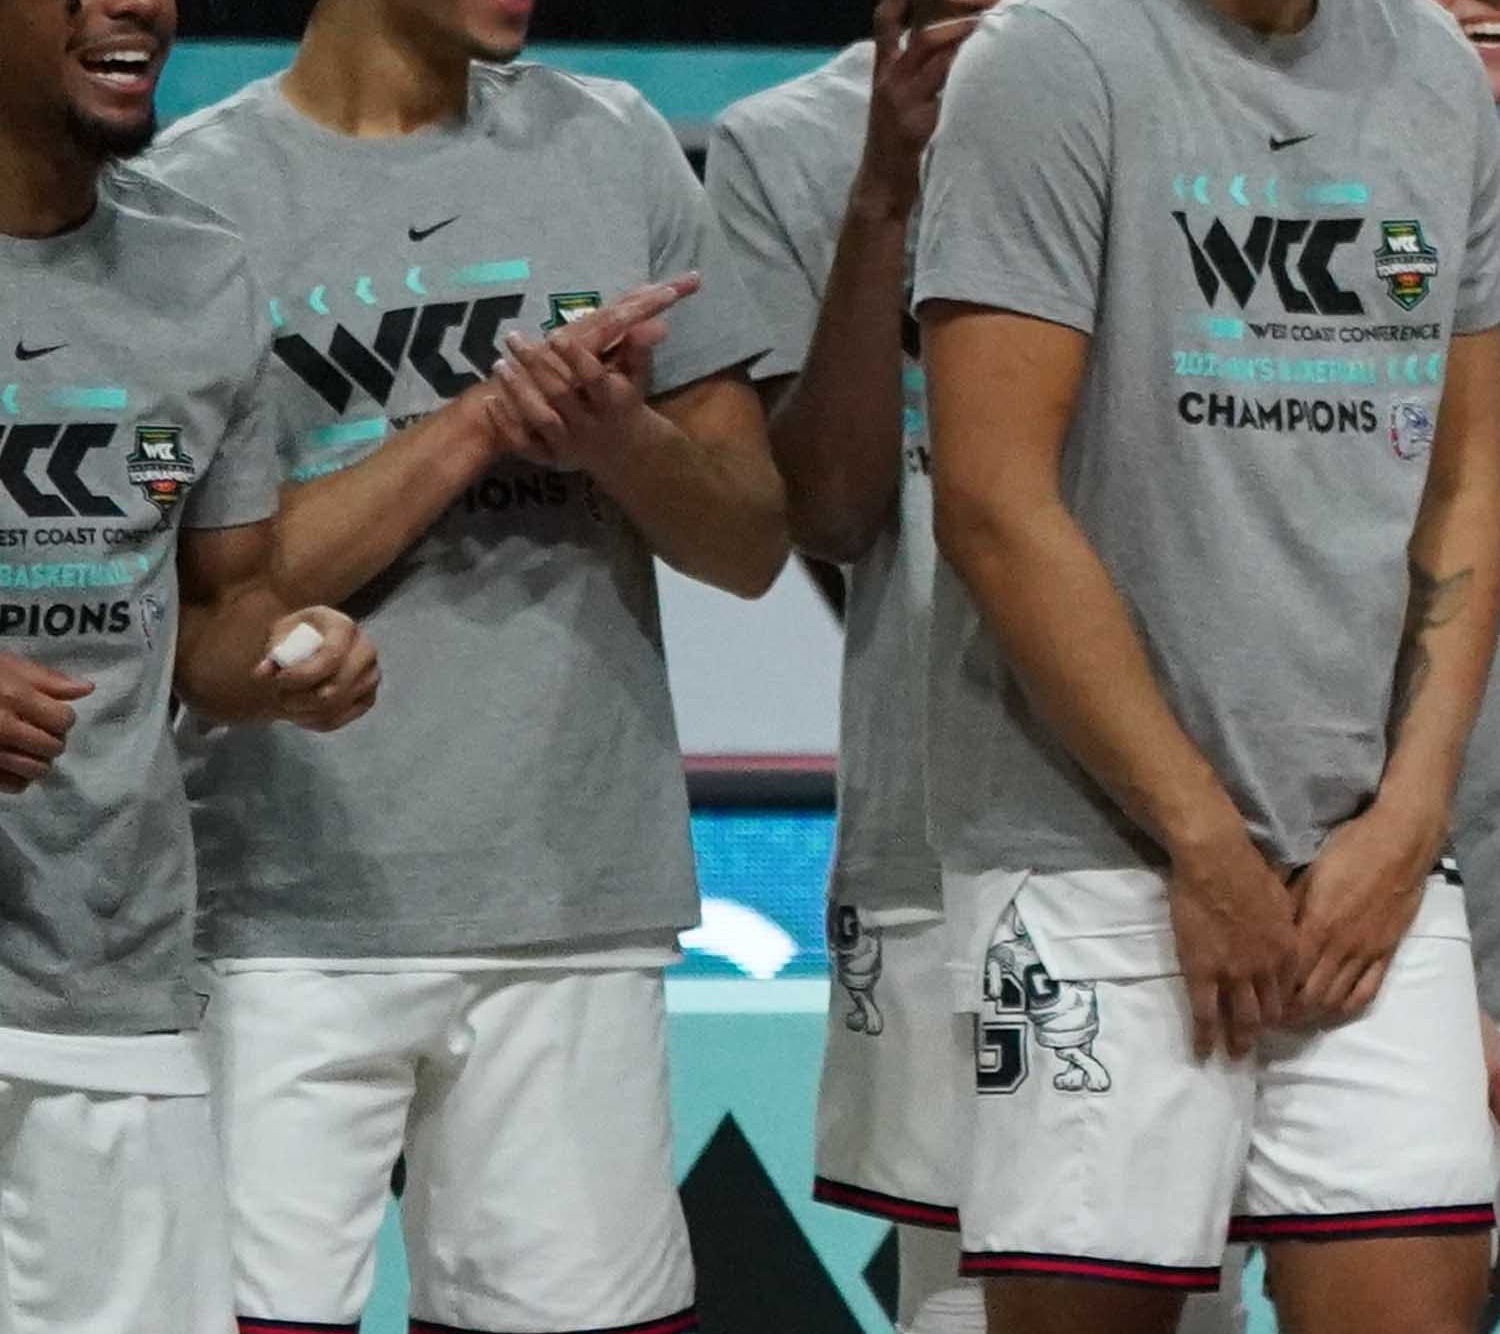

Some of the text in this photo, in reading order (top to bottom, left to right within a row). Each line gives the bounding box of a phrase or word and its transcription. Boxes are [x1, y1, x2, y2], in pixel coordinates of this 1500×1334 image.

[1170, 210, 1366, 317] WCC
[1177, 391, 1378, 434] CHAMPIONS
[34, 528, 97, 546] COAST
